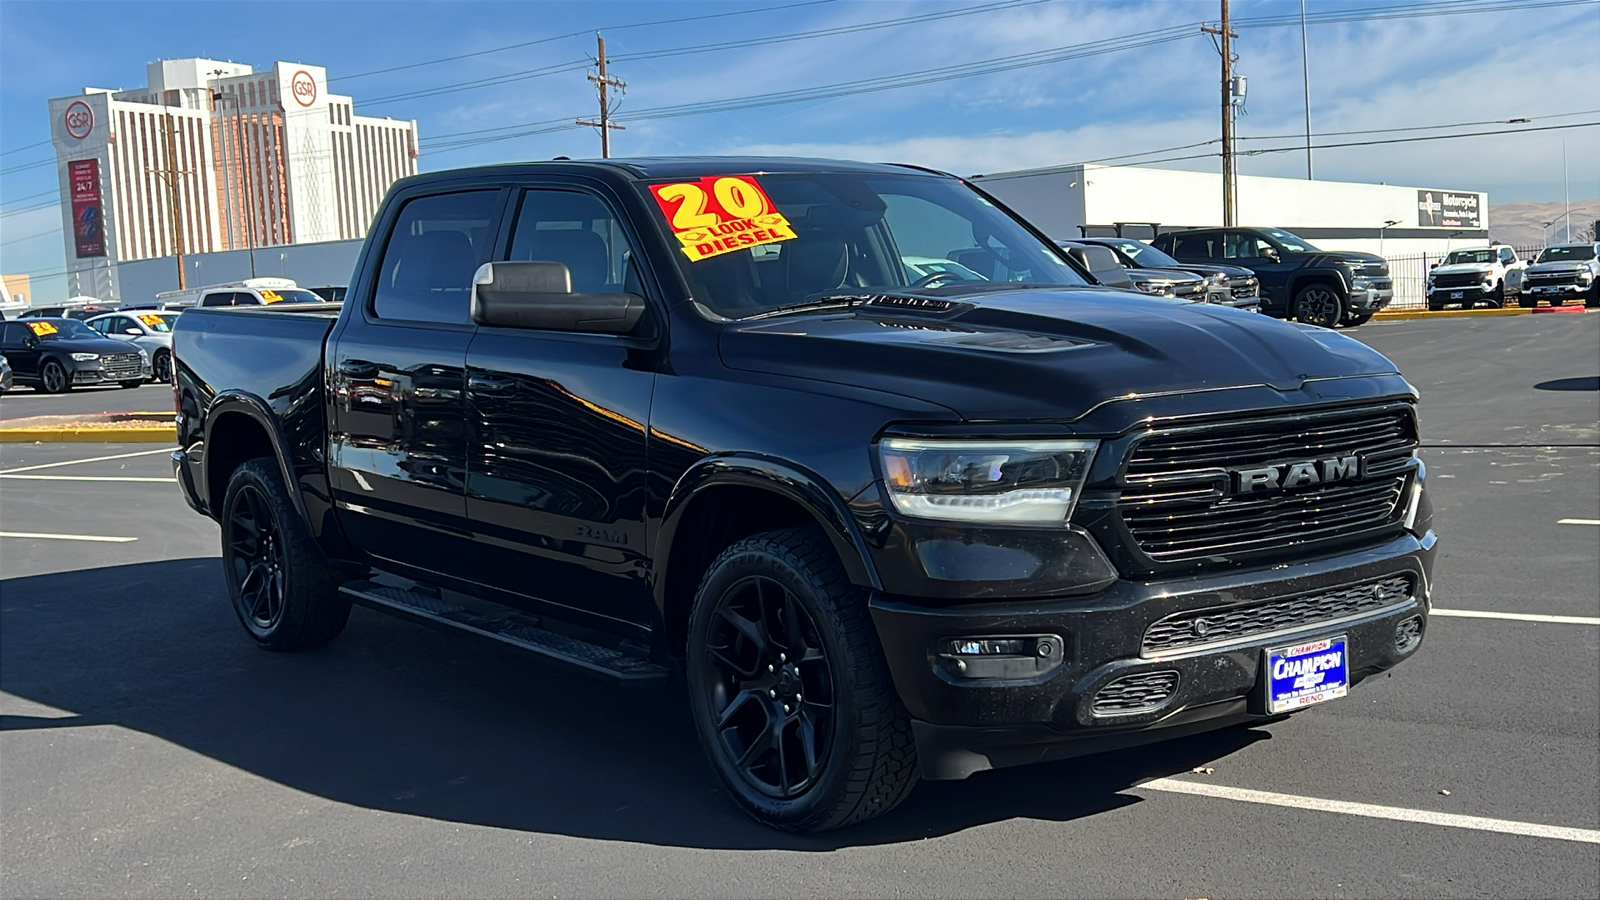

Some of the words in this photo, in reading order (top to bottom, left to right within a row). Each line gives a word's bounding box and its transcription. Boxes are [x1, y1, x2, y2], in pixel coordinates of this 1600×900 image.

[295, 81, 313, 97] GSR
[69, 112, 89, 128] GSR
[76, 181, 93, 191] 24/7
[657, 177, 768, 229] 20
[1443, 193, 1477, 210] Motorcycle
[707, 218, 760, 238] LOOK
[696, 228, 786, 256] DIESEL
[1238, 456, 1358, 494] RAM
[574, 524, 628, 545] RAM
[1290, 641, 1327, 656] CHAMPION
[1273, 651, 1341, 680] CHAMPION
[1299, 693, 1324, 704] RENO
